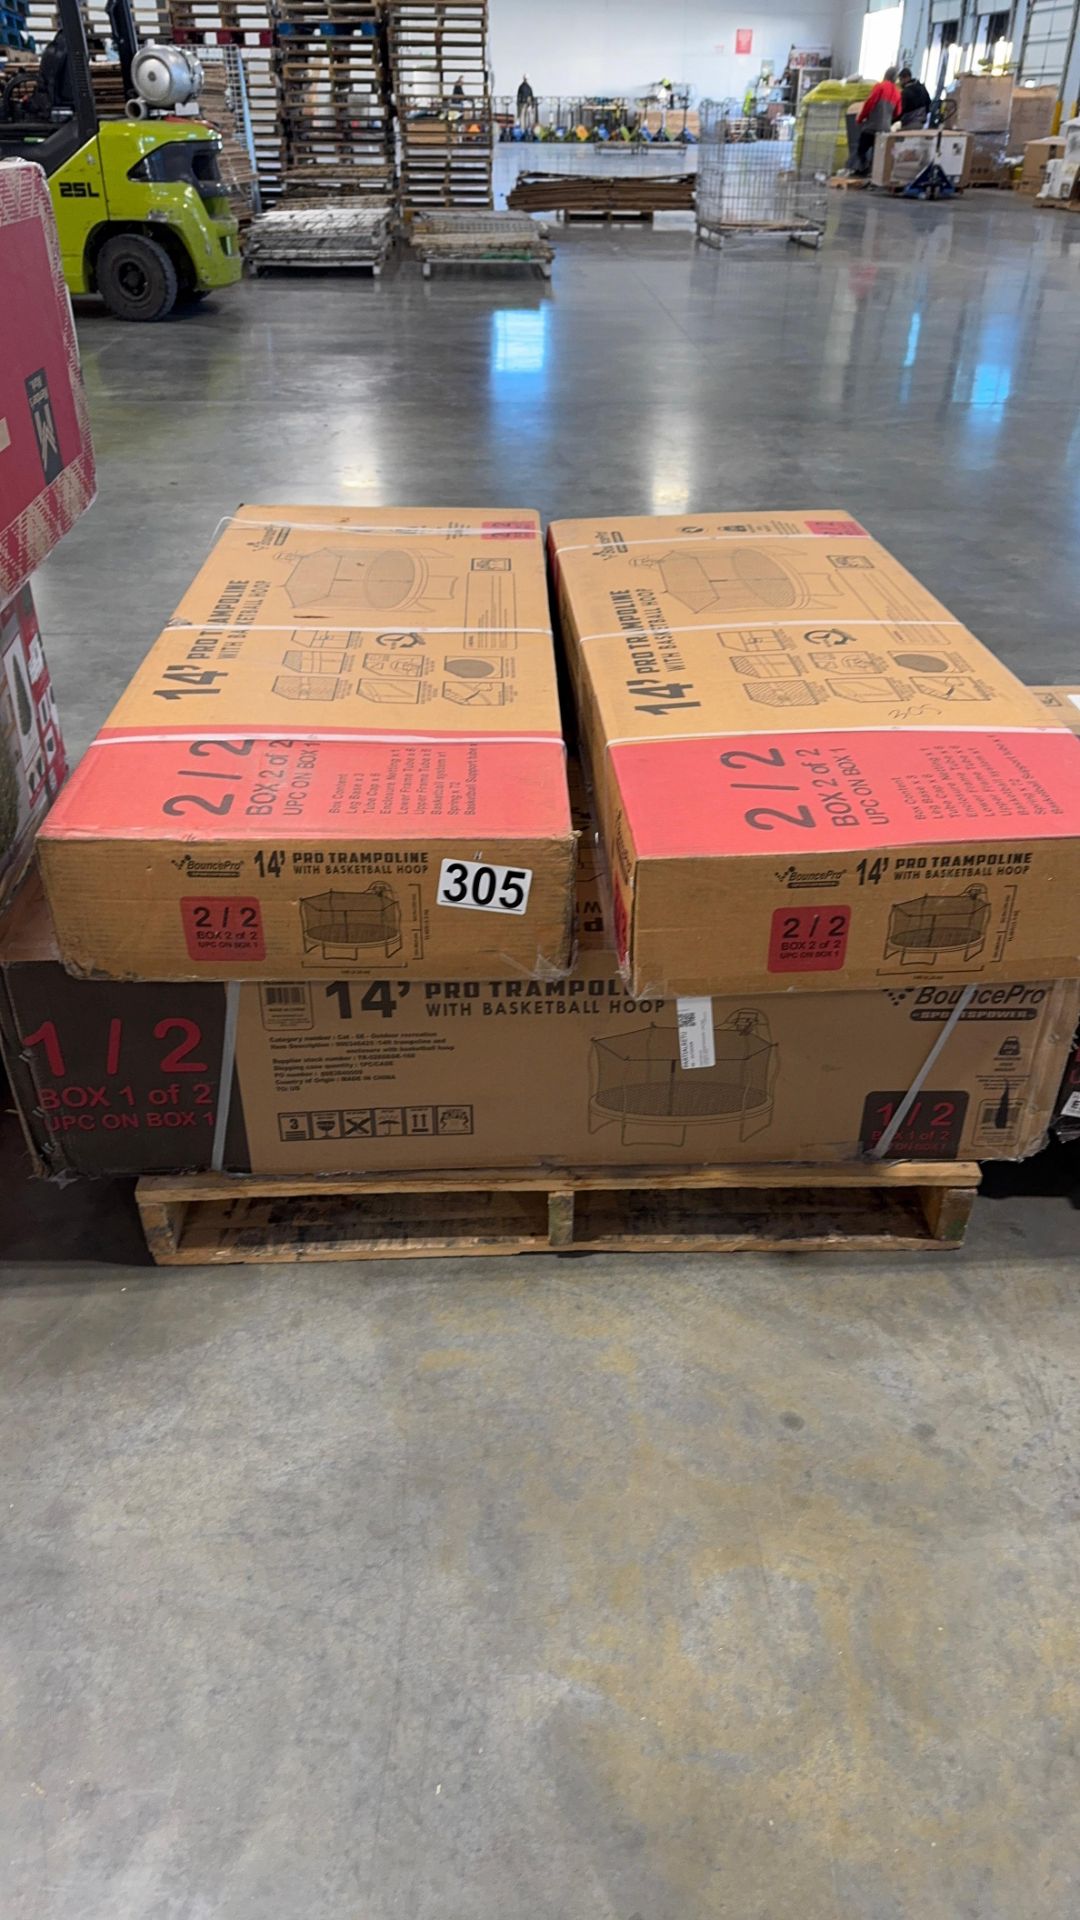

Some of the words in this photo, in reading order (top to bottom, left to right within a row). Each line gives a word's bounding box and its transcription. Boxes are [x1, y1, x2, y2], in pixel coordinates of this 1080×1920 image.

[59, 182, 99, 197] 25L
[248, 580, 272, 597] HOOP
[636, 588, 658, 606] HOOP
[199, 580, 250, 636] TAMPOLINE
[227, 599, 264, 638] BAKETBALL
[186, 639, 219, 659] PRO
[216, 641, 245, 659] WITH
[631, 651, 660, 674] PRO
[661, 652, 686, 672] WITH
[268, 739, 294, 748] 2
[795, 748, 821, 757] 2
[264, 752, 289, 766] of
[296, 749, 319, 769] BOX
[801, 762, 830, 774] of
[832, 755, 861, 776] BOX
[258, 769, 285, 778] 2
[290, 772, 312, 788] ON
[332, 774, 348, 799] Content
[812, 778, 839, 788] 2
[847, 778, 872, 796] ON
[245, 783, 280, 815] BOX
[283, 792, 307, 816] UPC
[328, 801, 342, 814] Box
[818, 791, 860, 828] BOX
[860, 799, 890, 825] UPC
[292, 853, 324, 863] PRO
[328, 852, 428, 863] TRAMPOLINE
[895, 858, 927, 870] PRO
[932, 853, 1033, 868] TRAMPOLINE
[293, 865, 321, 875] WITH
[325, 864, 392, 875] BASKETBALL
[396, 864, 428, 874] HOOP
[894, 871, 920, 881] WITH
[925, 867, 992, 879] BASKETBALL
[996, 865, 1031, 875] HOOP
[443, 863, 527, 909] 305
[196, 931, 221, 940] BOX
[224, 931, 232, 940] 2
[250, 931, 258, 940] 2
[781, 941, 806, 951] BOX
[808, 940, 816, 950] 2
[833, 939, 841, 948] 2
[425, 981, 480, 999] PRO
[426, 1003, 472, 1017] WITH
[482, 1001, 600, 1016] BASKETBALL
[608, 999, 665, 1014] HOOP
[919, 1010, 1028, 1019] SPOTSPOWER
[22, 1020, 65, 1077] 1
[153, 1017, 208, 1072] 2
[38, 1086, 111, 1110] BOX
[119, 1085, 136, 1106] 1
[149, 1084, 181, 1105] of
[193, 1083, 214, 1105] 2
[43, 1114, 96, 1132] UPC
[101, 1113, 139, 1129] ON
[146, 1111, 197, 1127] BOX
[203, 1111, 215, 1126] 1
[872, 1131, 903, 1140] BX
